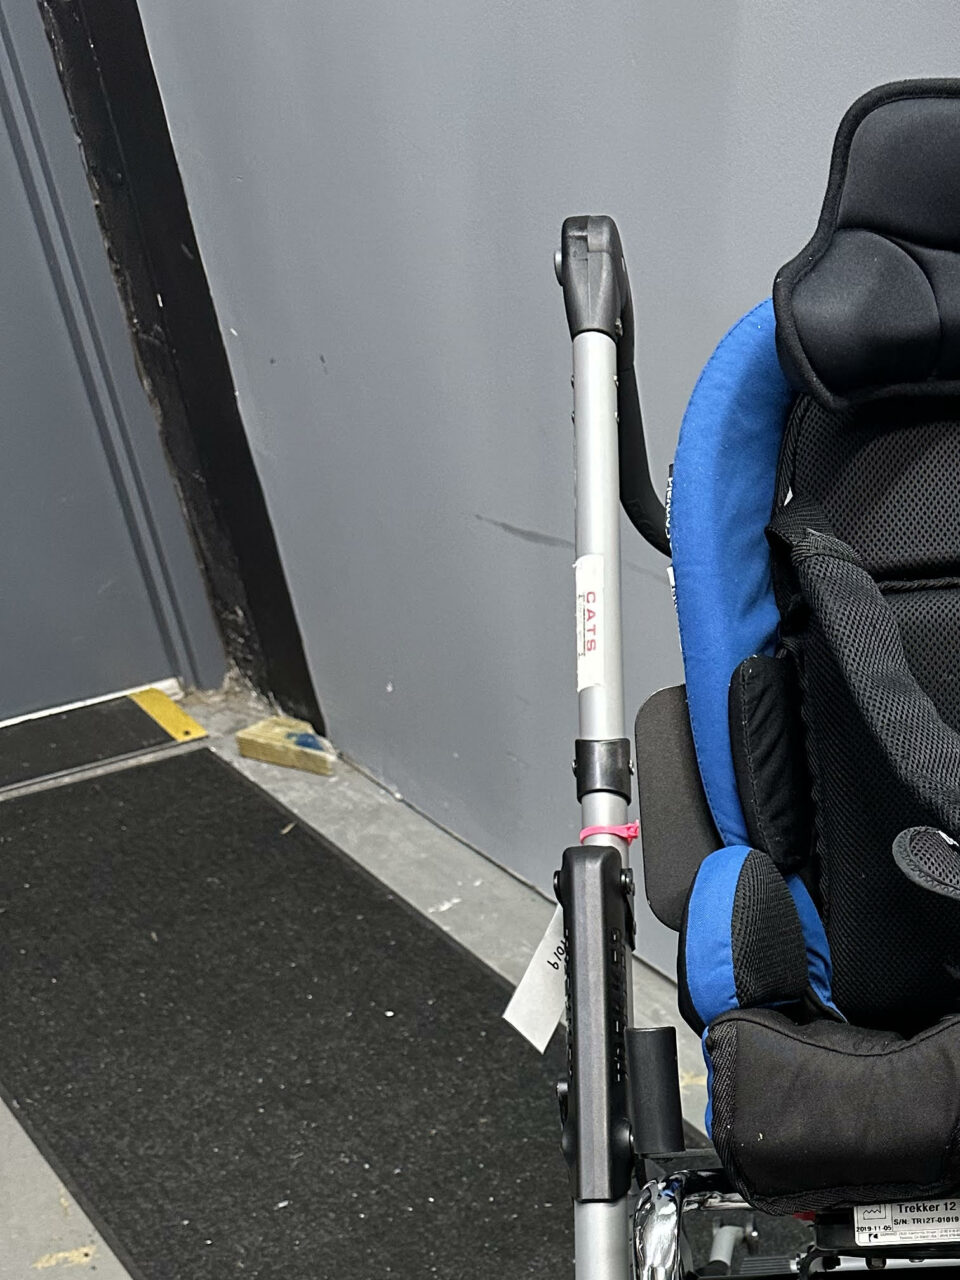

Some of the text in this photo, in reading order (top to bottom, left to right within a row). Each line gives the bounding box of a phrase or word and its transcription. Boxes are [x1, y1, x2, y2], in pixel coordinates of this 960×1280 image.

[586, 591, 597, 652] CATS
[897, 1201, 957, 1214] Trekker 12
